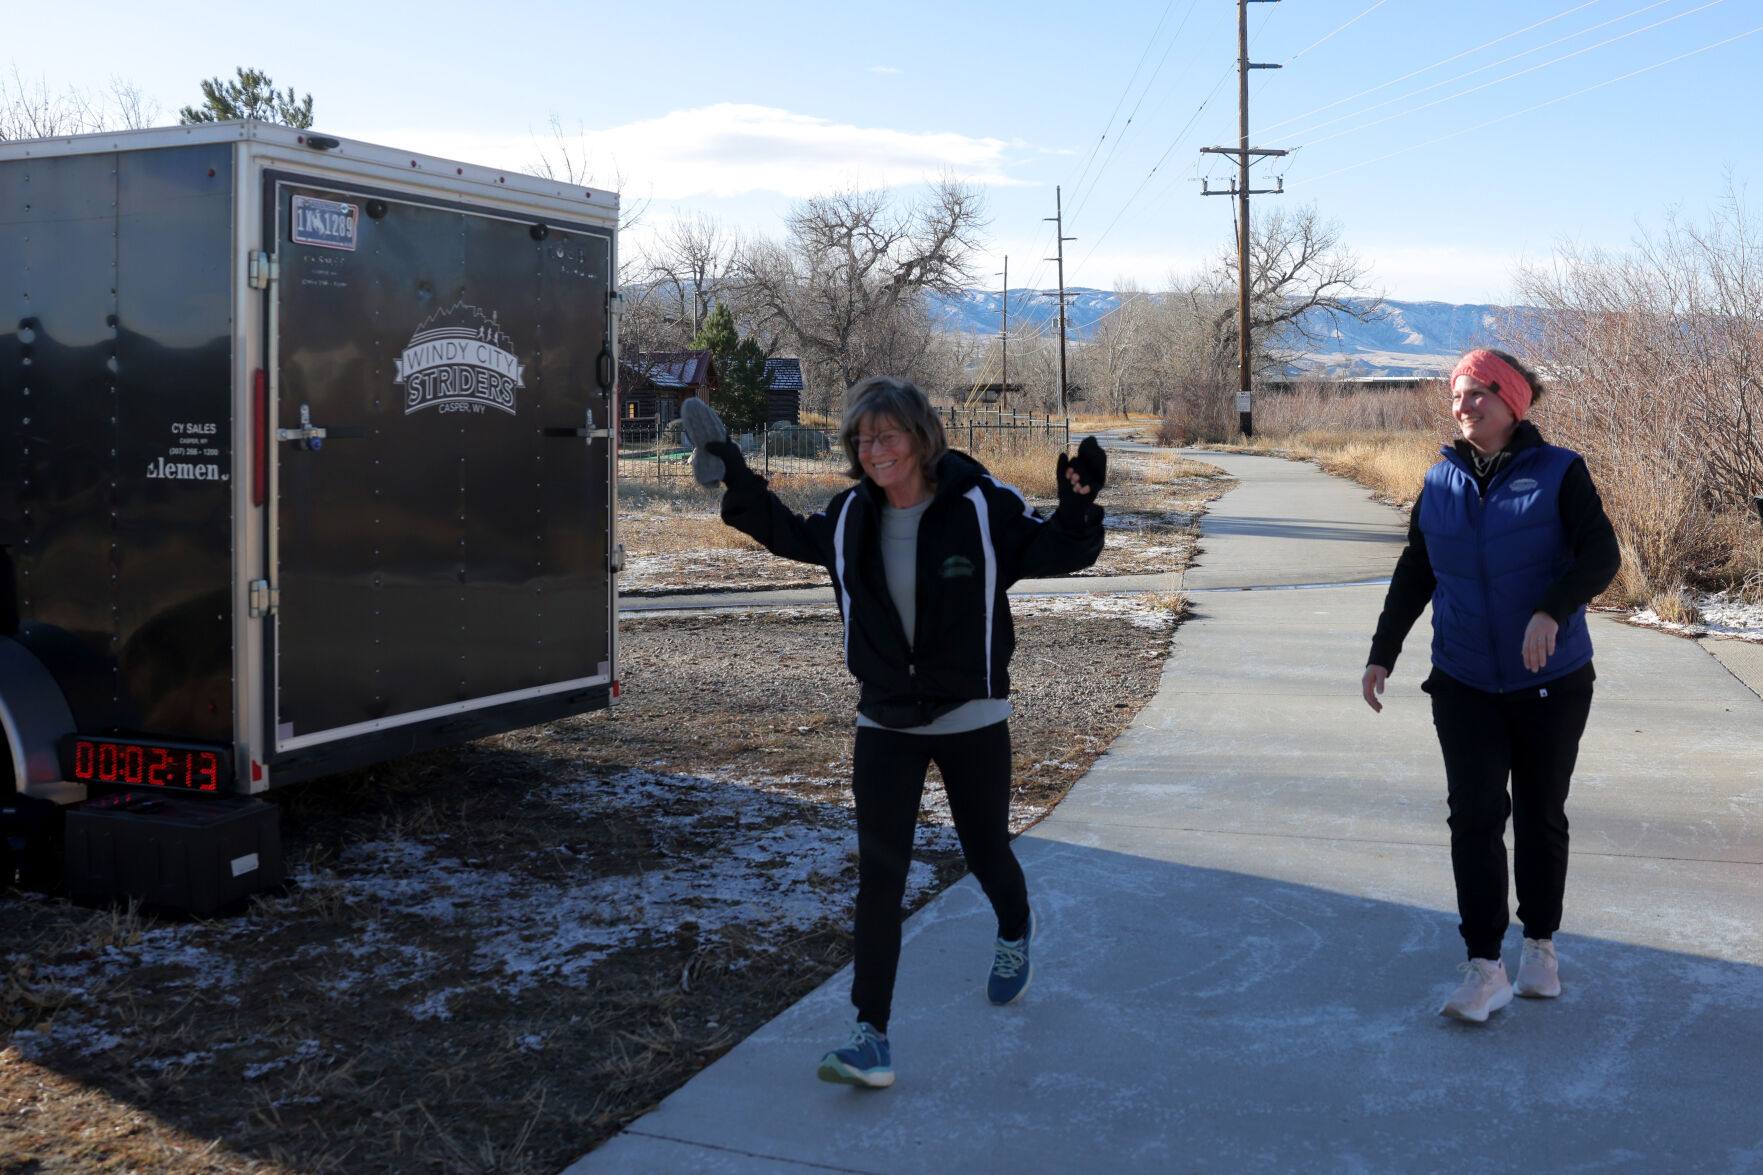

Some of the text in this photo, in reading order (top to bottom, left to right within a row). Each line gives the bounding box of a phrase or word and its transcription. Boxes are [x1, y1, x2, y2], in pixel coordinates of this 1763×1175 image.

[324, 212, 353, 238] 1289
[406, 342, 515, 374] WINDY CITY
[407, 365, 514, 407] STRIDERS
[438, 402, 486, 414] CASPER, WY
[171, 423, 216, 434] CY SALES
[75, 741, 217, 791] 00:02:13
